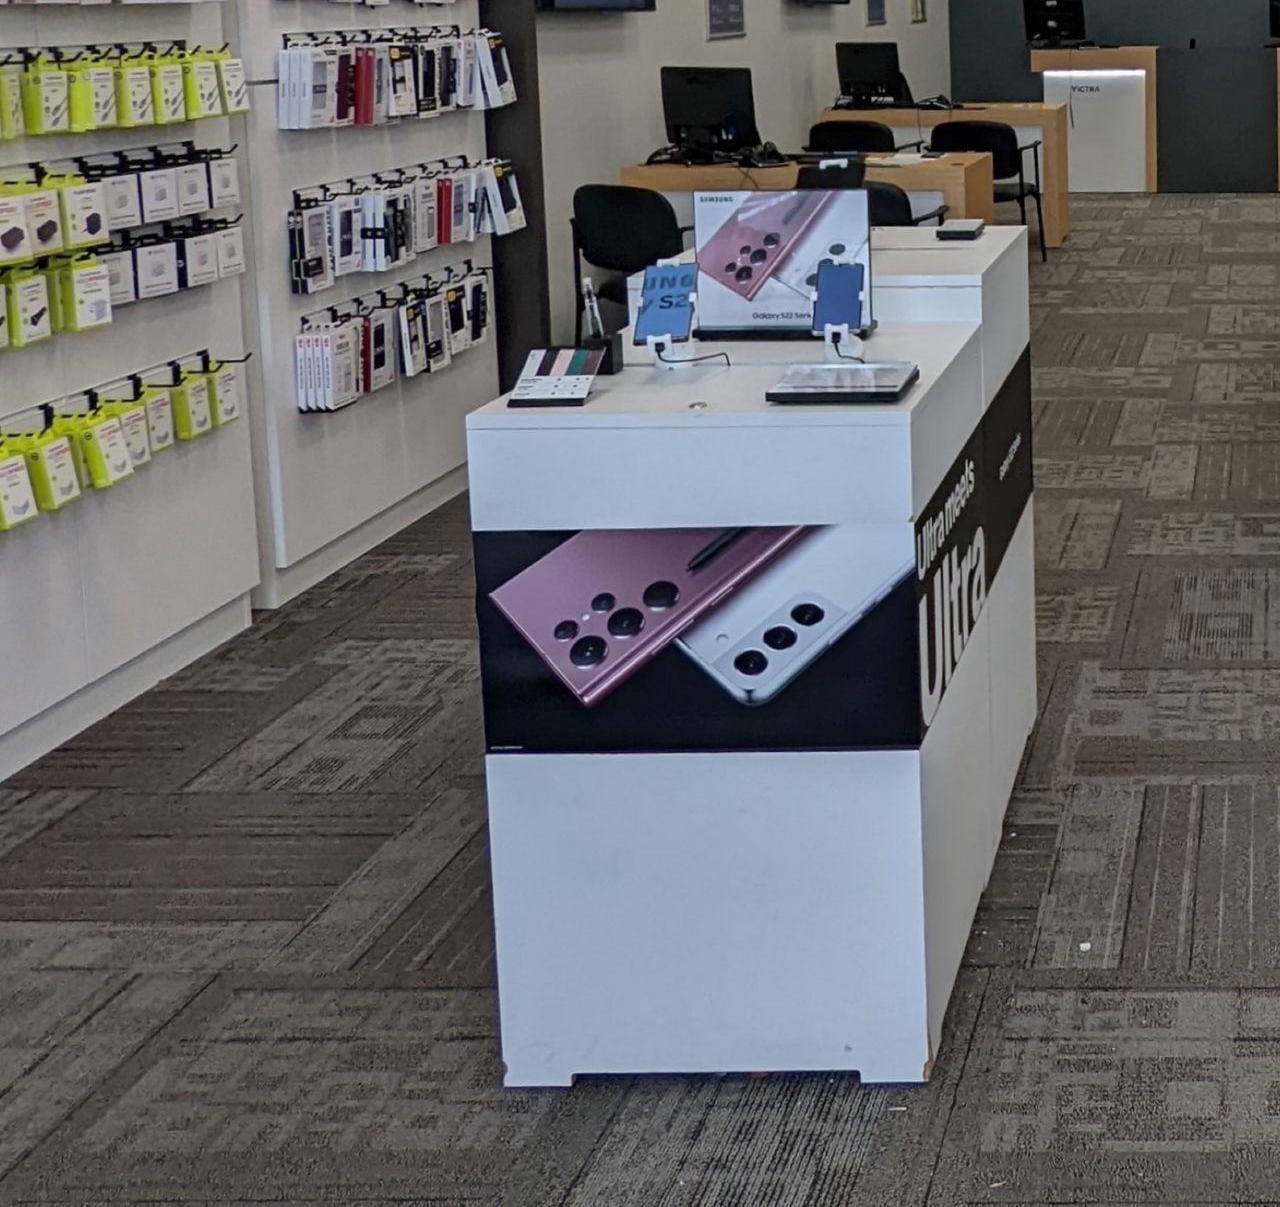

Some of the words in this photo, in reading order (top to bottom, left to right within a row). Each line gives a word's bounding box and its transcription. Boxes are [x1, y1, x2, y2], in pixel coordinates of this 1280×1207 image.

[752, 311, 780, 321] Galaxy
[917, 509, 945, 581] Ultra
[944, 458, 975, 536] meets
[918, 525, 987, 727] Ultra
